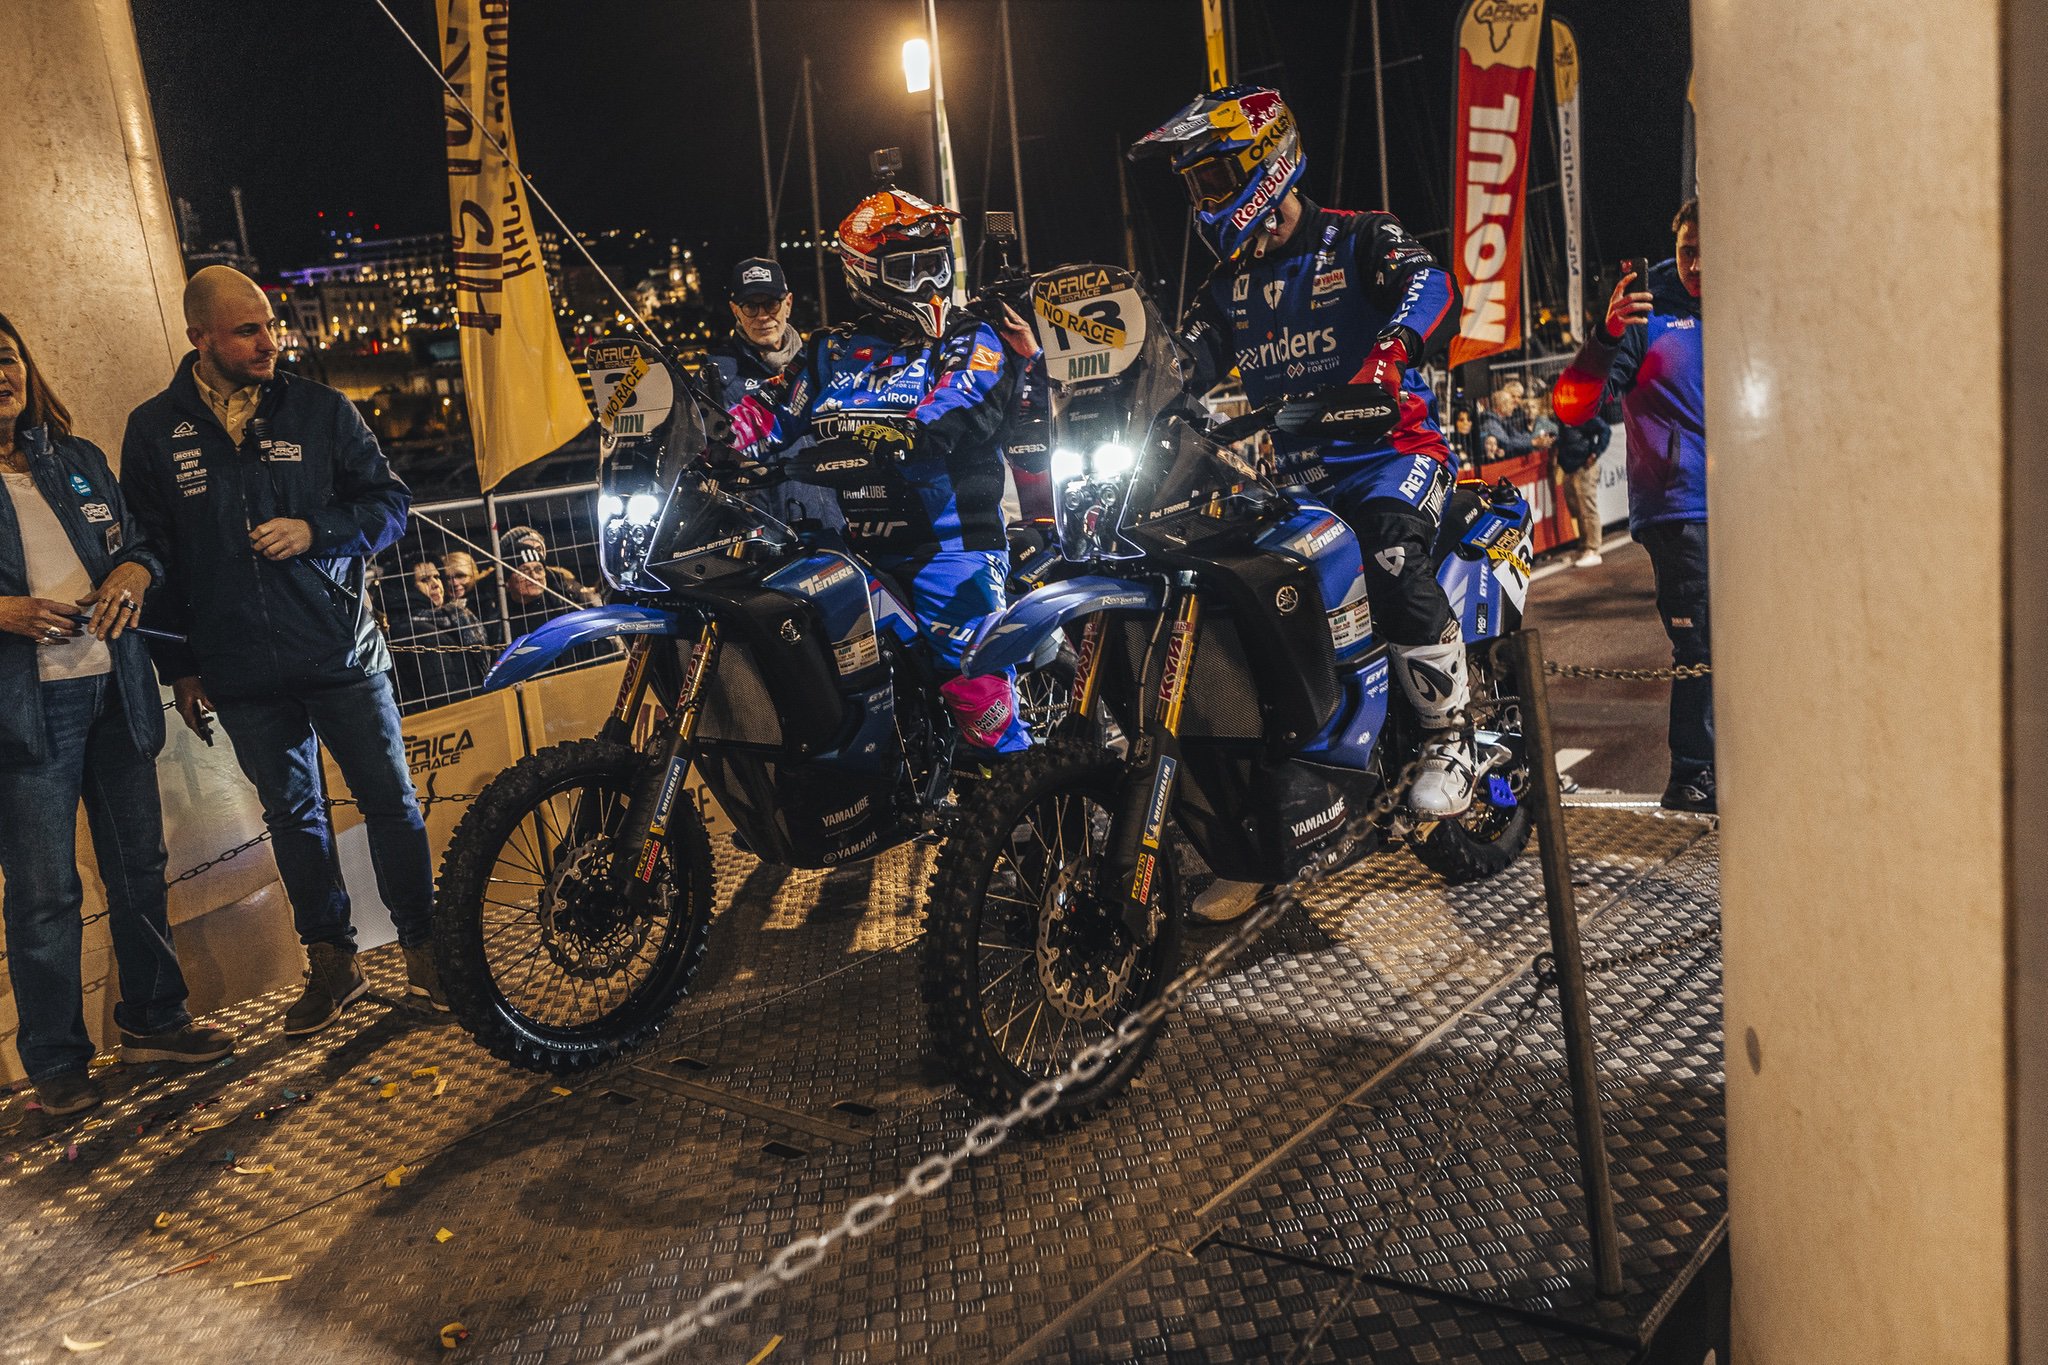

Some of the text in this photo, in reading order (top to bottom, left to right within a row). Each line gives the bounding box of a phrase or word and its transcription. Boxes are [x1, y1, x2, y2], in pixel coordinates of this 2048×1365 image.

[1232, 156, 1293, 230] Red Bull
[1460, 94, 1520, 344] MOTUL
[1046, 269, 1111, 300] AFRICA
[1042, 302, 1116, 346] NO RACE
[595, 345, 641, 362] AFRICA
[1068, 352, 1111, 379] AMV
[1260, 326, 1338, 368] riders
[604, 362, 644, 421] NO RACE
[614, 414, 645, 434] AMV
[1320, 404, 1393, 423] ACERBIS
[180, 459, 199, 471] AMV
[815, 457, 869, 473] ACERBIS
[1478, 562, 1489, 599] GYTR
[661, 763, 681, 813] MICHELIN
[1153, 764, 1172, 822] MICHELIN
[821, 795, 870, 828] YAMALUBE
[1290, 796, 1346, 838] YAMALUBE
[643, 841, 661, 883] BRAKING
[837, 831, 879, 859] YAMAHA
[1140, 855, 1155, 905] BRAKING
